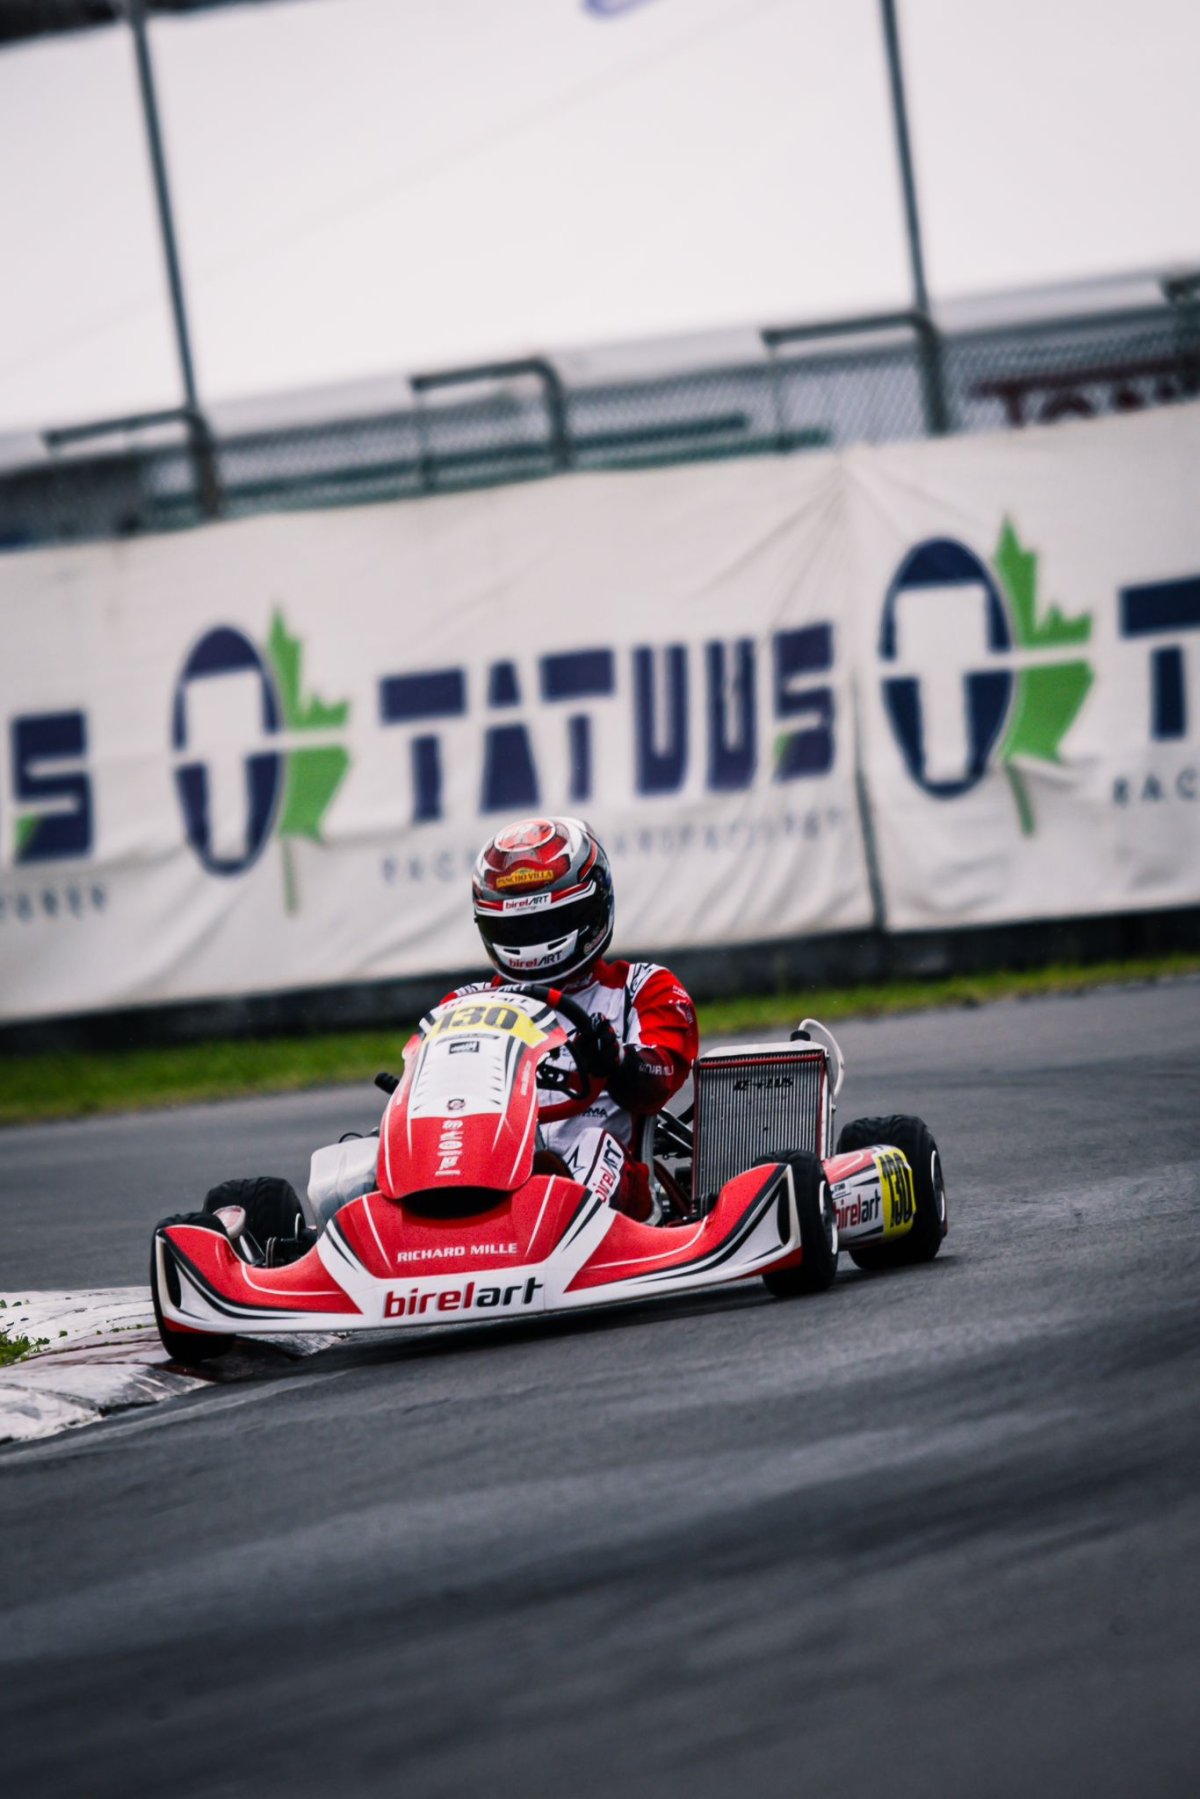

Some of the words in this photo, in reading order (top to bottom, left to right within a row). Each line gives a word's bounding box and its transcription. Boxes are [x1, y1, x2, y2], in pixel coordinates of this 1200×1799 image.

[379, 620, 834, 823] TATUUS
[528, 870, 552, 881] VILLA
[505, 894, 549, 910] birelART
[508, 951, 563, 968] birelART
[438, 1006, 519, 1032] 130
[397, 1245, 466, 1263] RICHARD
[470, 1242, 518, 1256] MILLE
[383, 1276, 544, 1319] birelart
